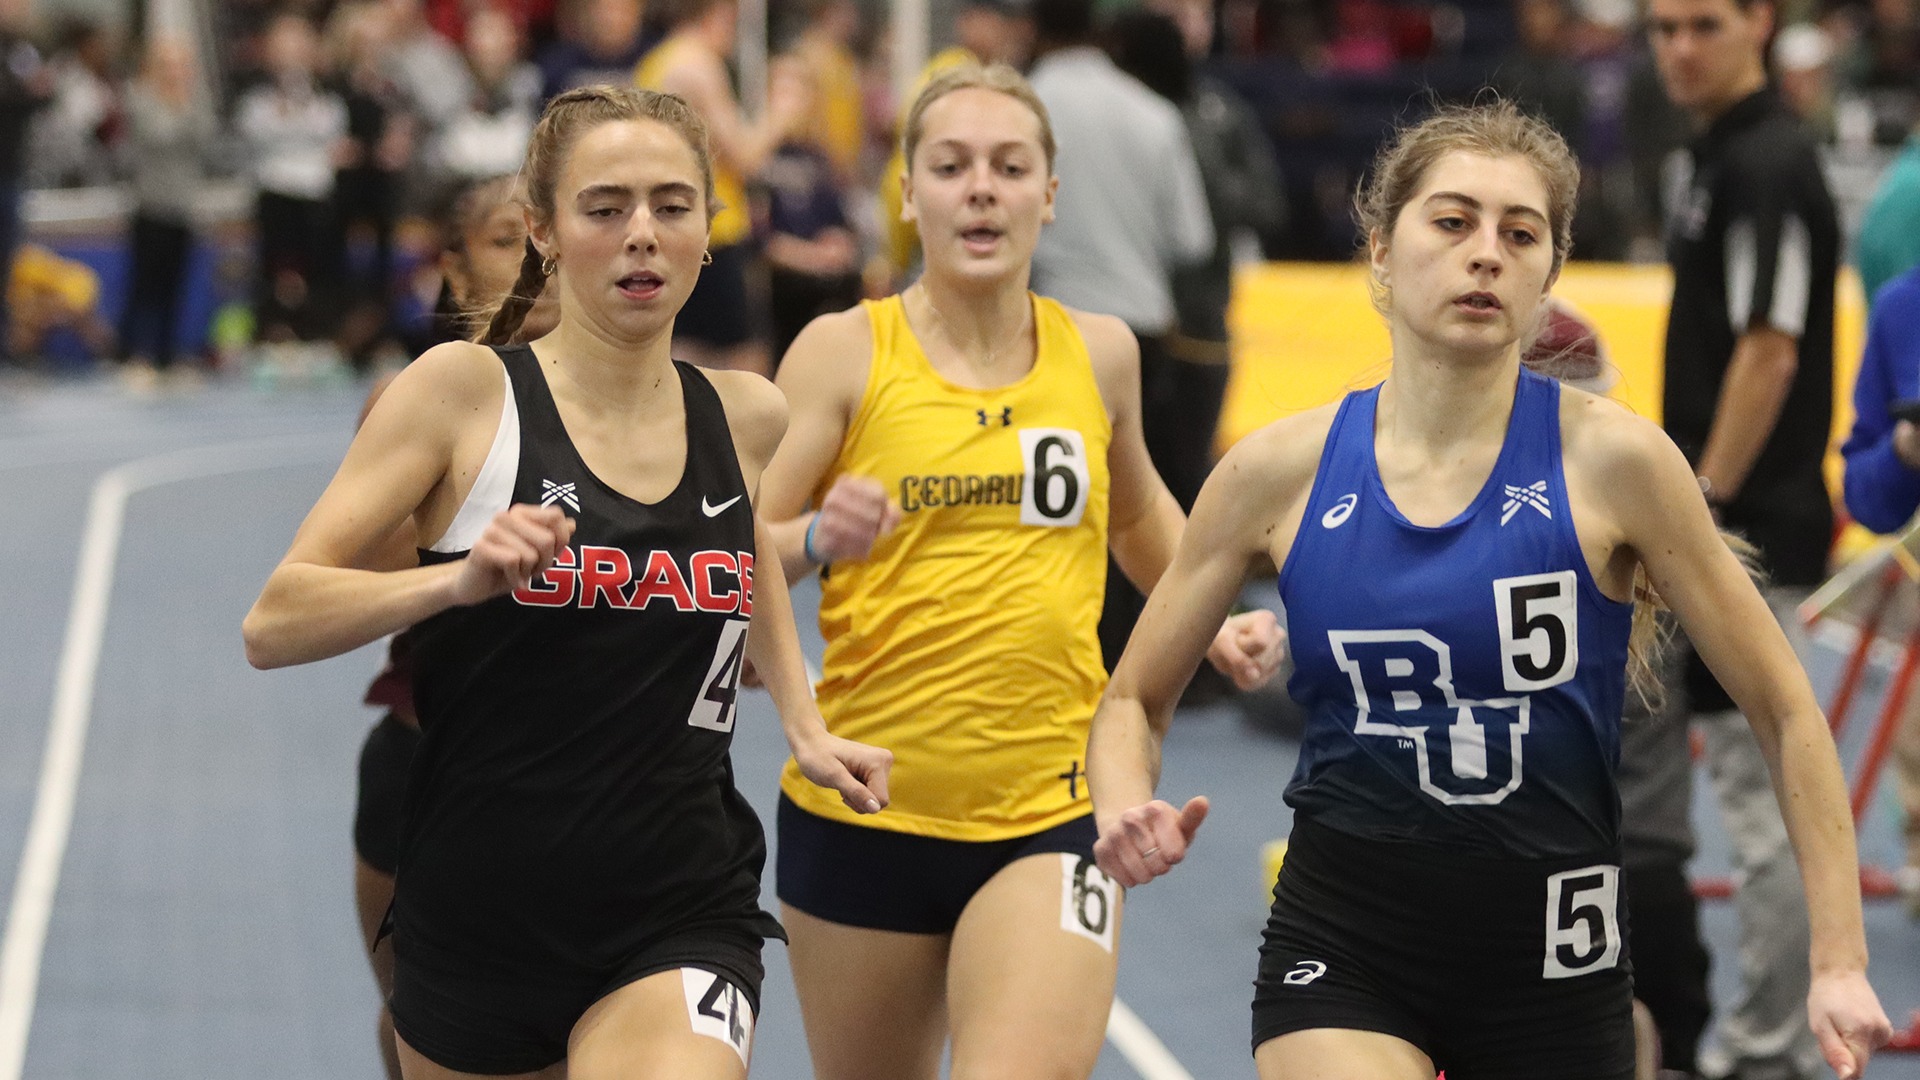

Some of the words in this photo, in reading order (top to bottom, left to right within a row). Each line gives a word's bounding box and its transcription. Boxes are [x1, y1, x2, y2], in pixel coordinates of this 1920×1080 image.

[1034, 435, 1079, 519] 6
[703, 628, 748, 724] 4
[1510, 581, 1567, 682] 5
[1327, 628, 1531, 806] BU
[1396, 738, 1414, 749] TM
[1072, 857, 1110, 936] 6
[1555, 872, 1607, 969] 5
[697, 975, 745, 1049] 4
